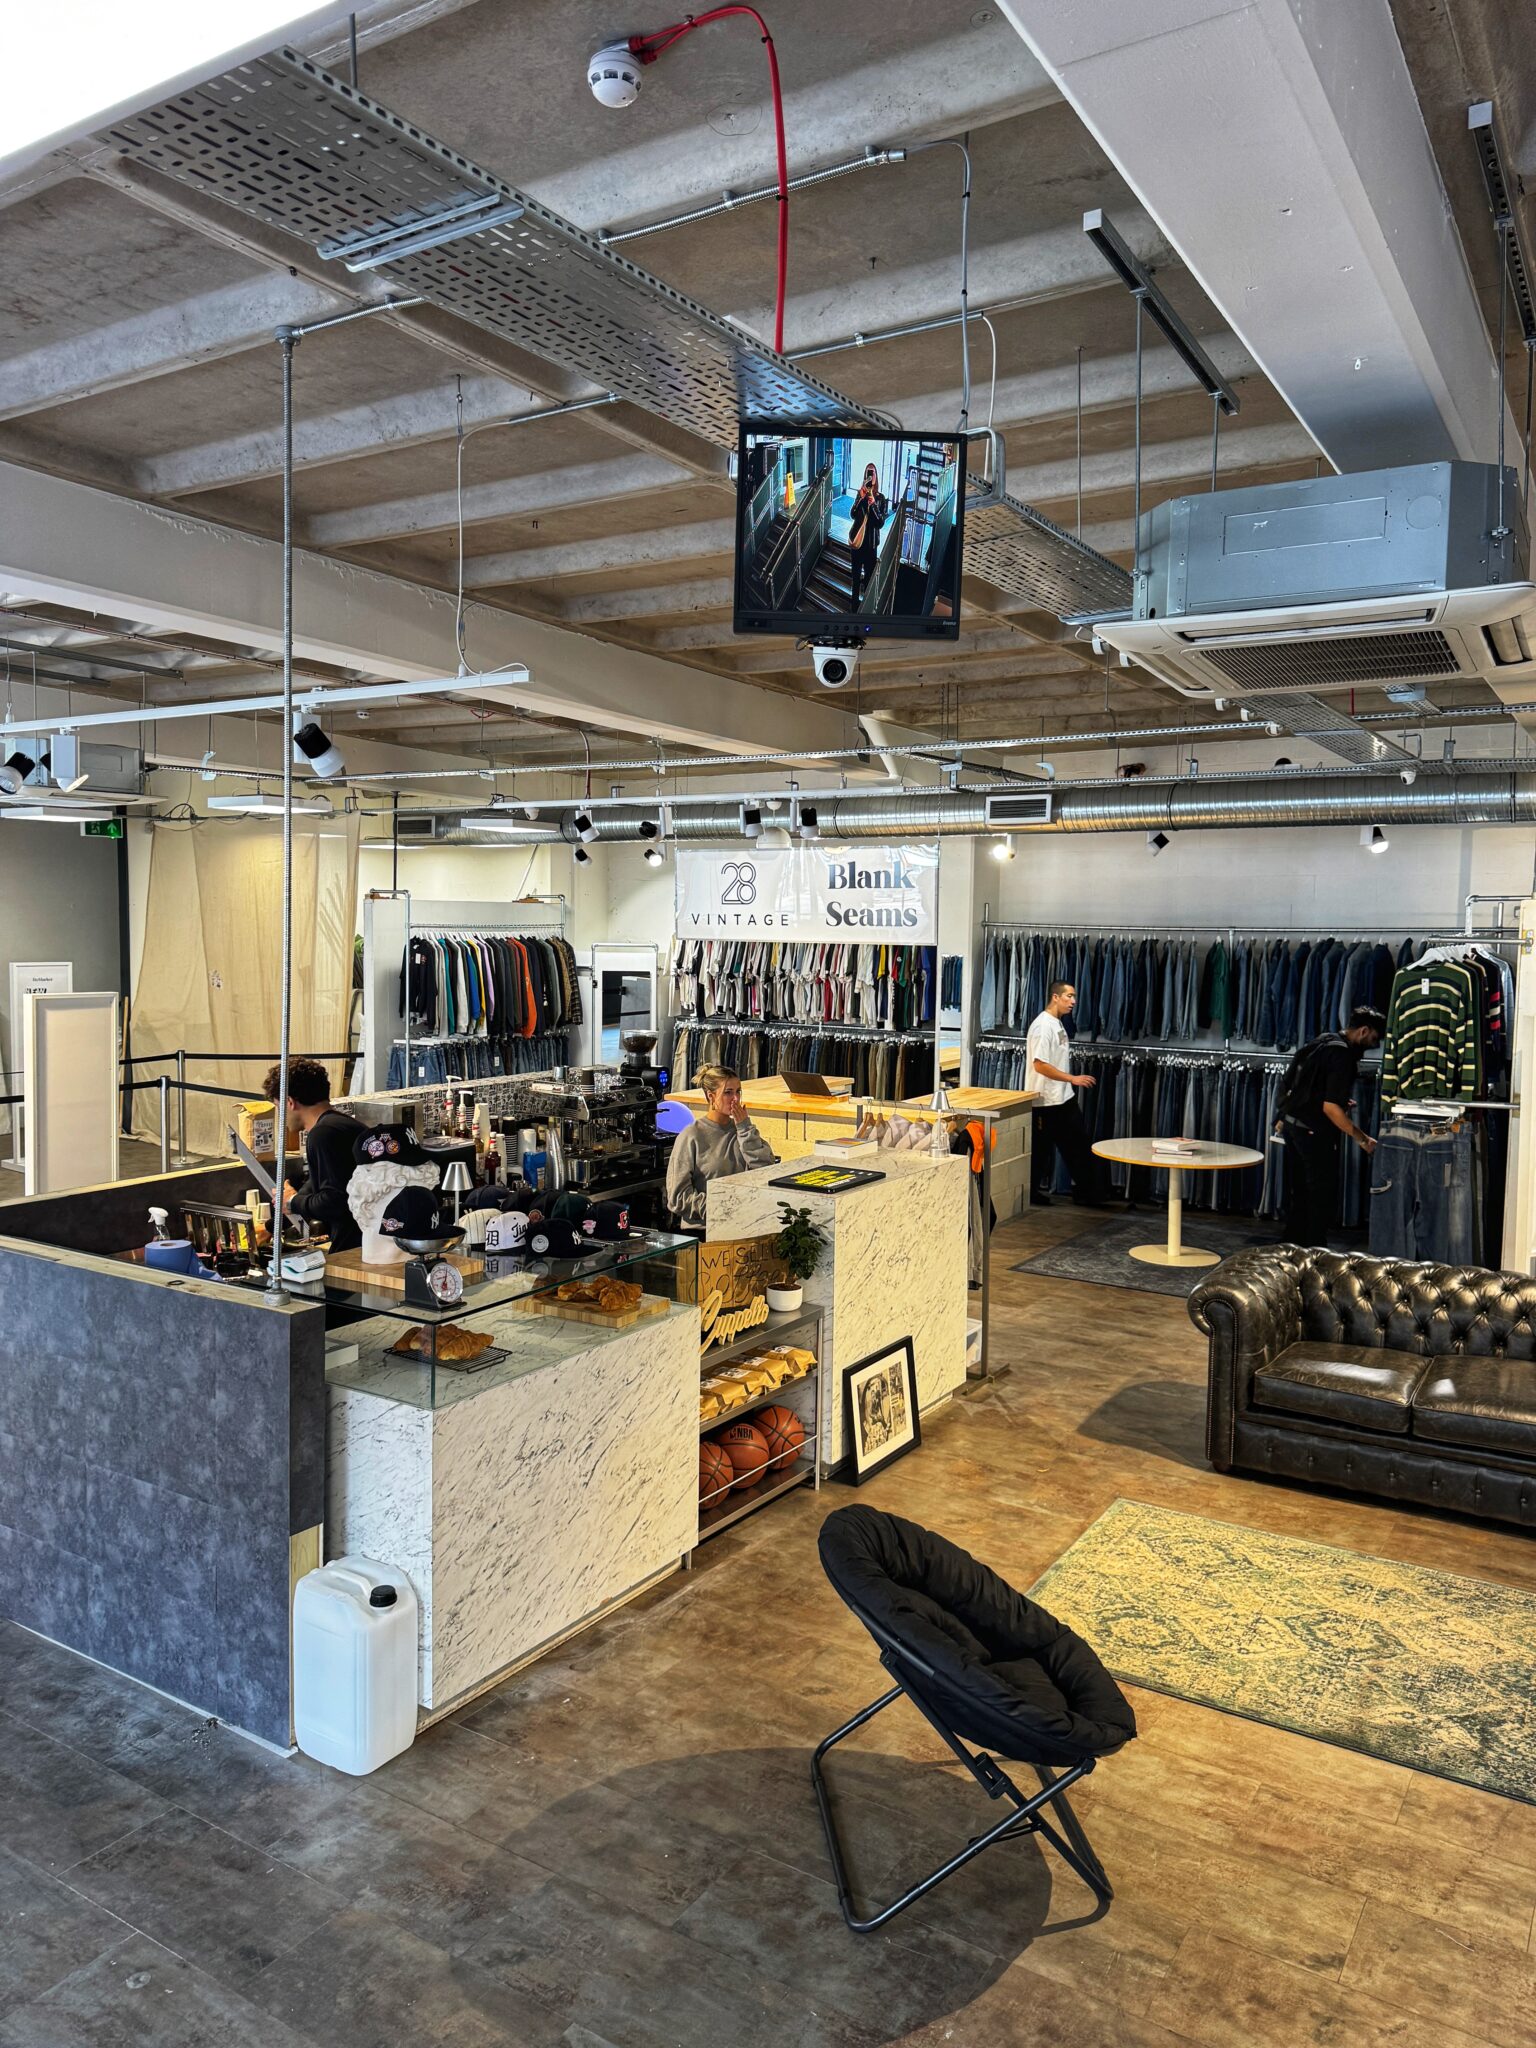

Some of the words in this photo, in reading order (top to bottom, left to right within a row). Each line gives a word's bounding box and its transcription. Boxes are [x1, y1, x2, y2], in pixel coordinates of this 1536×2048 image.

[721, 862, 757, 905] 28
[828, 861, 916, 890] Blank
[691, 913, 790, 926] VINTAGE
[825, 902, 918, 927] Seams
[701, 1250, 731, 1269] WE
[737, 1427, 754, 1440] NBA
